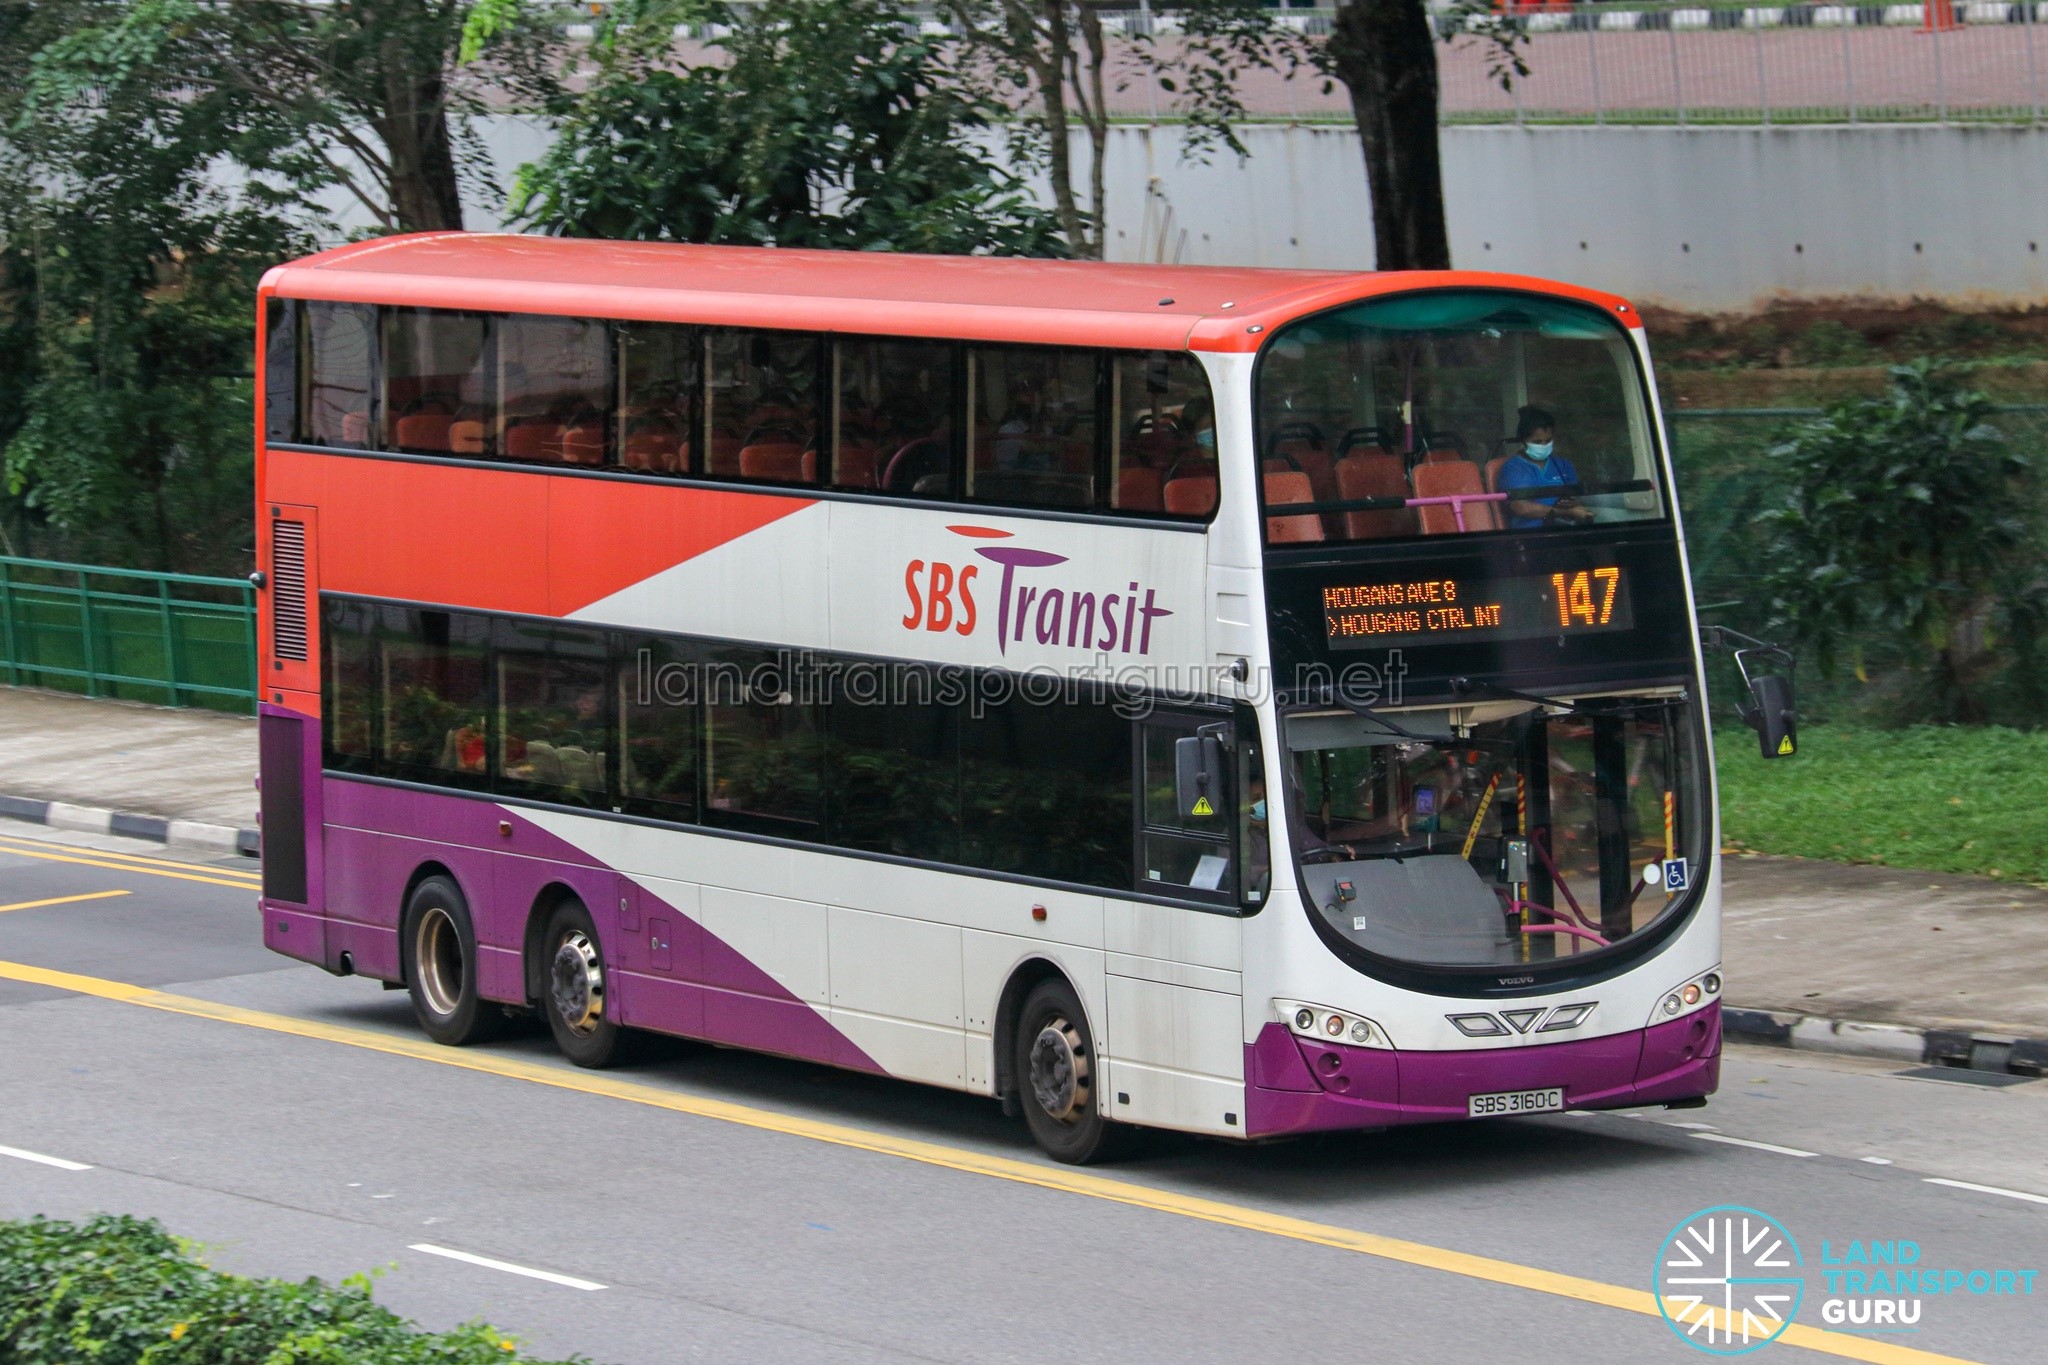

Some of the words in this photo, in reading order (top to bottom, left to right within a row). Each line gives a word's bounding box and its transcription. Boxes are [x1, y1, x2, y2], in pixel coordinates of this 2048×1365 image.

[902, 559, 979, 637] SBS
[973, 546, 1175, 658] Transit
[1324, 584, 1405, 609] HOUGANG
[1406, 581, 1442, 604] AVE
[1443, 580, 1457, 601] 8
[1552, 566, 1620, 627] 147
[1426, 607, 1473, 630] CTRL
[1474, 604, 1501, 627] INT
[1497, 975, 1535, 986] VOLVO
